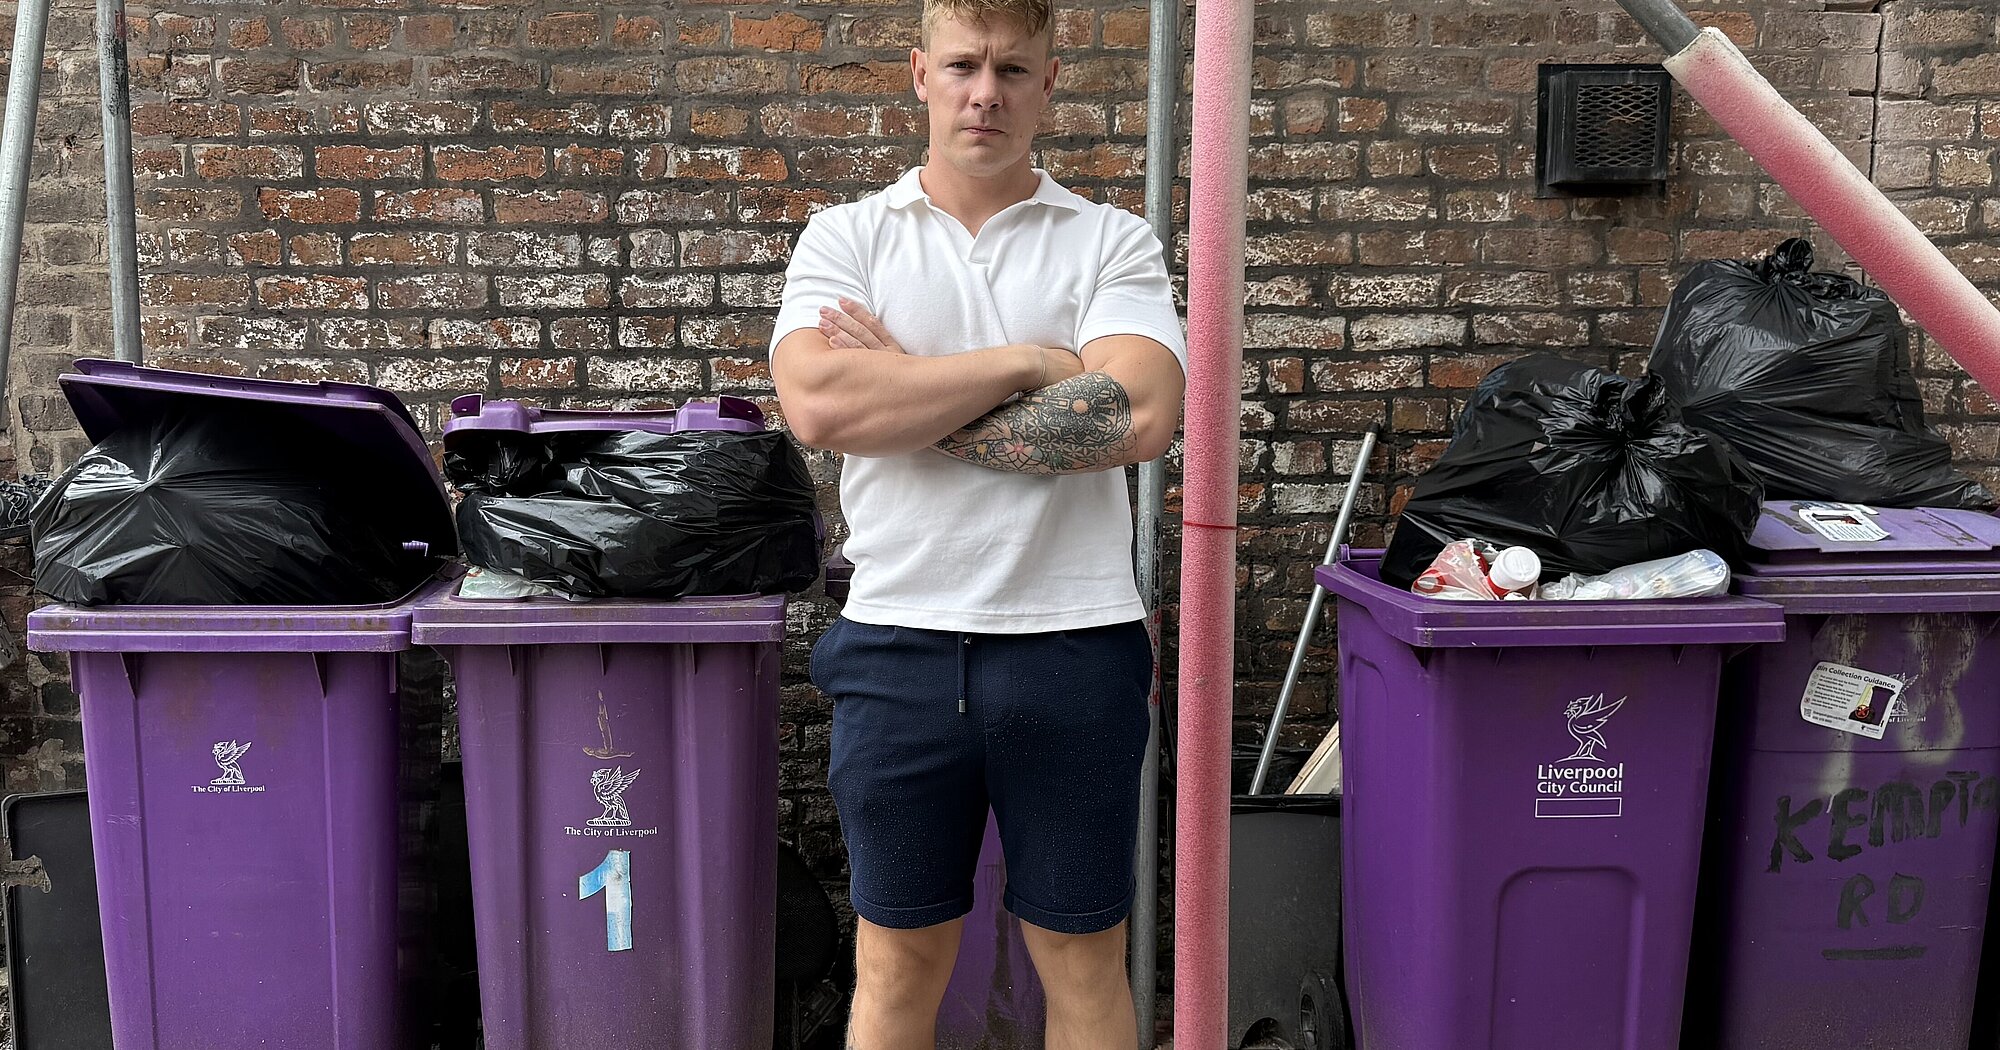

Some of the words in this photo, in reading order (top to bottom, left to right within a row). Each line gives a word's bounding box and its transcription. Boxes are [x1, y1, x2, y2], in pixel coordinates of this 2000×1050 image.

[1828, 667, 1862, 681] Collection
[1863, 675, 1896, 689] Guidance
[1538, 762, 1623, 784] Liverpool
[191, 785, 206, 793] The
[207, 785, 222, 794] City
[223, 785, 231, 793] of
[232, 785, 265, 794] Liverpool
[1537, 780, 1566, 797] City
[1569, 780, 1622, 793] Council
[564, 826, 581, 836] The
[583, 827, 602, 838] City
[604, 828, 614, 837] of
[616, 826, 658, 838] Liverpool
[579, 849, 632, 952] 1
